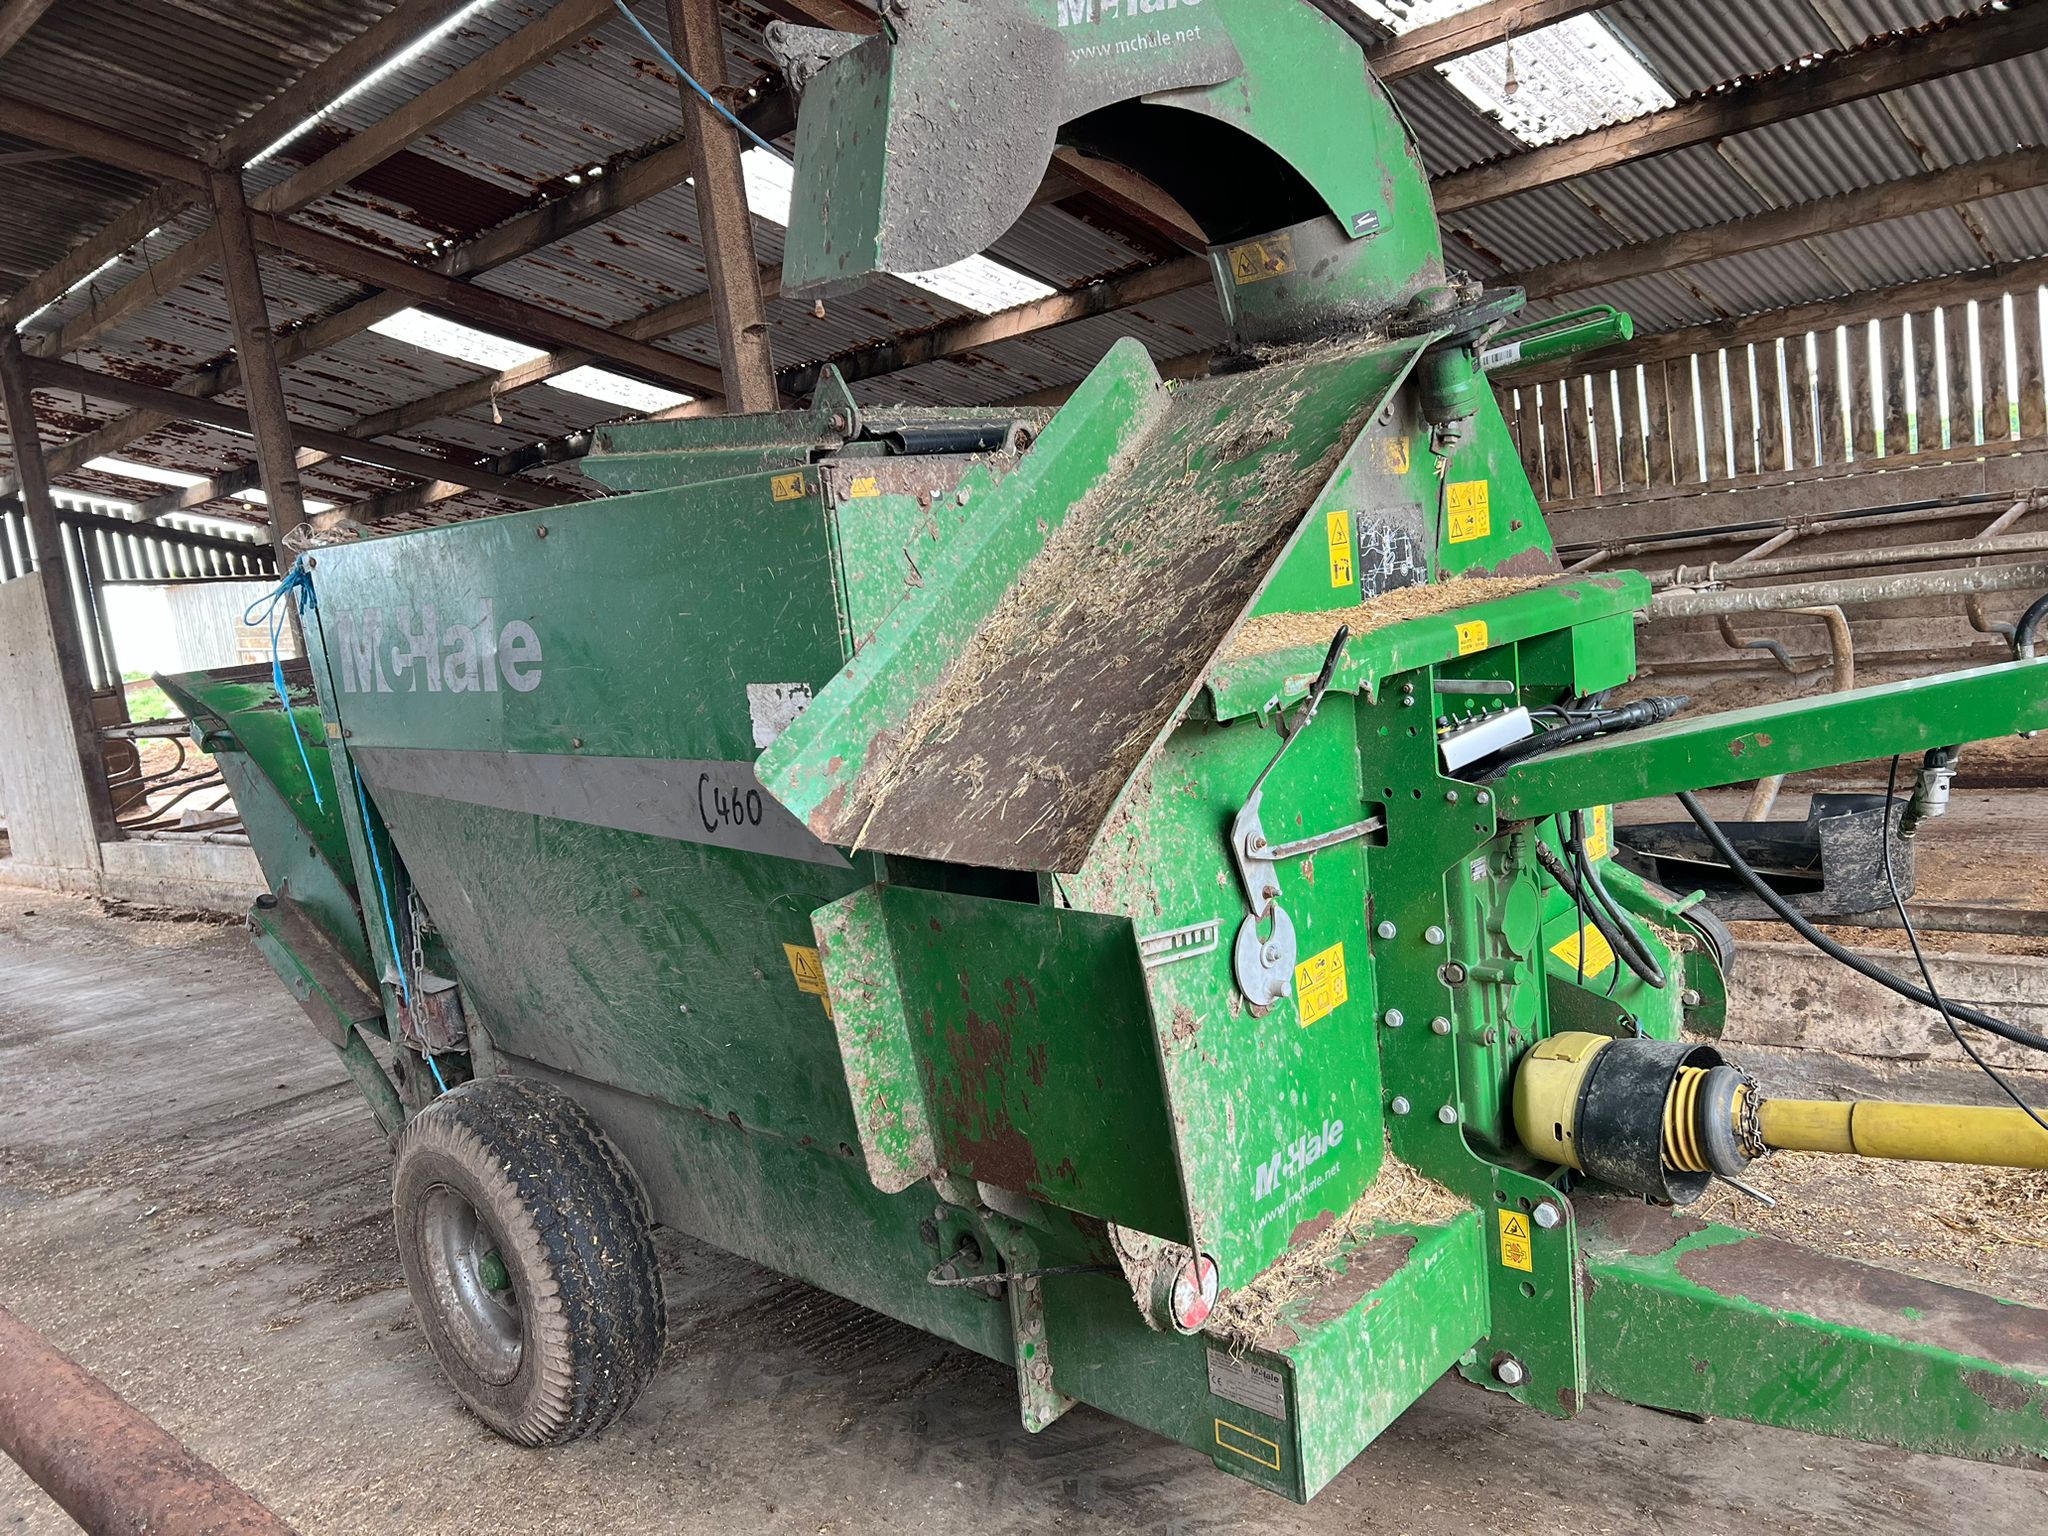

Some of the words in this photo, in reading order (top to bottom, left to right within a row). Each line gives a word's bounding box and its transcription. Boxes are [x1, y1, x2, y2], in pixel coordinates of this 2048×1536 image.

[1068, 25, 1202, 63] wwwmchalenet
[335, 597, 543, 693] McHale
[698, 772, 763, 833] C460
[1255, 1119, 1344, 1202] McHale
[1257, 1161, 1341, 1230] www.mchale.net
